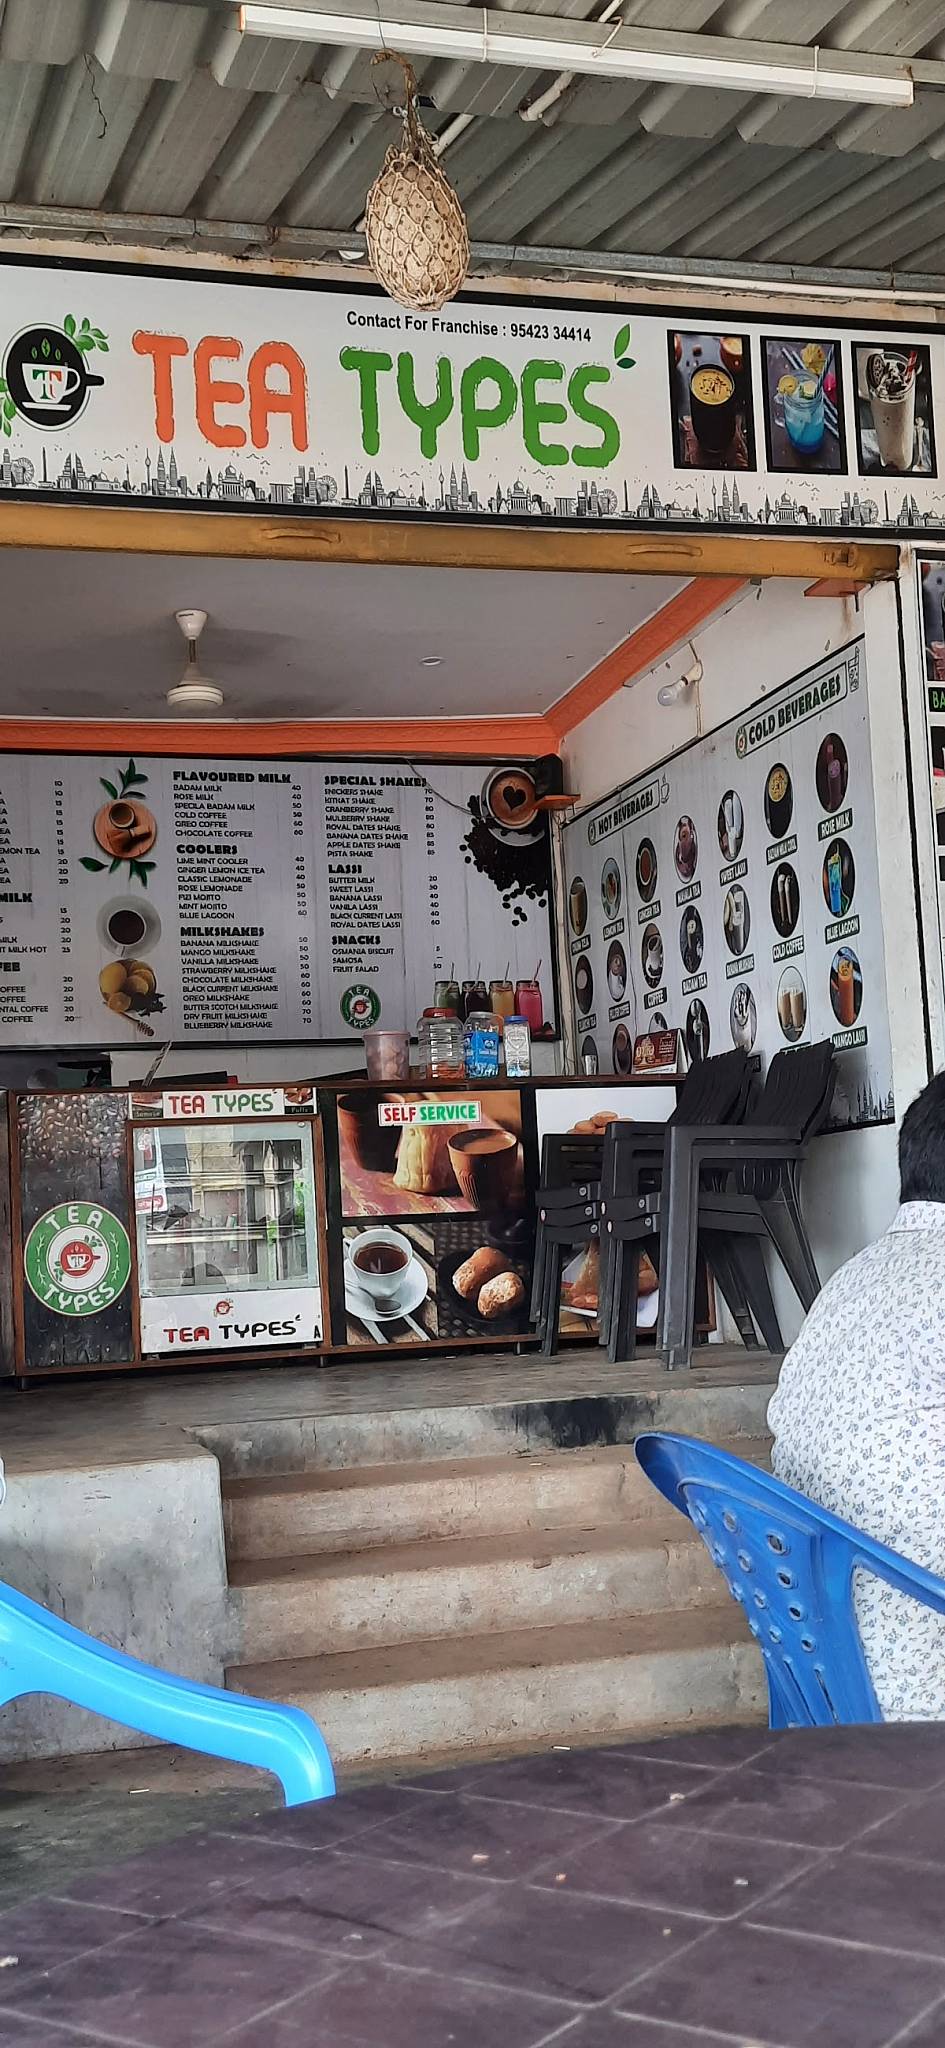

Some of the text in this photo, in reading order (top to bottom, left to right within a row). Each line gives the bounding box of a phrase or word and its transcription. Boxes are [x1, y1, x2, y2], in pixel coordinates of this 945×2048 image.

[347, 310, 401, 331] Contact
[404, 315, 428, 331] For
[431, 316, 498, 336] Franchise
[510, 322, 550, 339] 95423
[553, 325, 591, 342] 34414
[131, 329, 620, 469] TEA TYPES
[749, 712, 775, 745] COLD
[778, 673, 841, 728] BEVERAGES
[173, 772, 291, 783] FLAVOURED MILK
[325, 776, 376, 785] SPECIAL
[598, 815, 612, 835] HOT
[613, 789, 653, 826] BEVERAGES
[821, 811, 850, 836] ROSE MILK
[177, 845, 237, 854] COOLERS
[328, 865, 362, 874] LASSI
[181, 927, 264, 936] MILKSHAKES
[332, 936, 380, 944] SNACKS
[826, 919, 858, 940] BLUE LAGOON
[773, 938, 804, 959] COLD COFFEE
[349, 986, 370, 996] TEA
[348, 1016, 374, 1028] TYPES
[833, 1034, 852, 1049] MANGO
[168, 1093, 274, 1115] TEA TYPES
[384, 1105, 477, 1122] SELF SERVICE
[45, 1205, 103, 1230] TEA
[43, 1281, 115, 1312] TYPES
[164, 1321, 297, 1343] TEA TYPES
